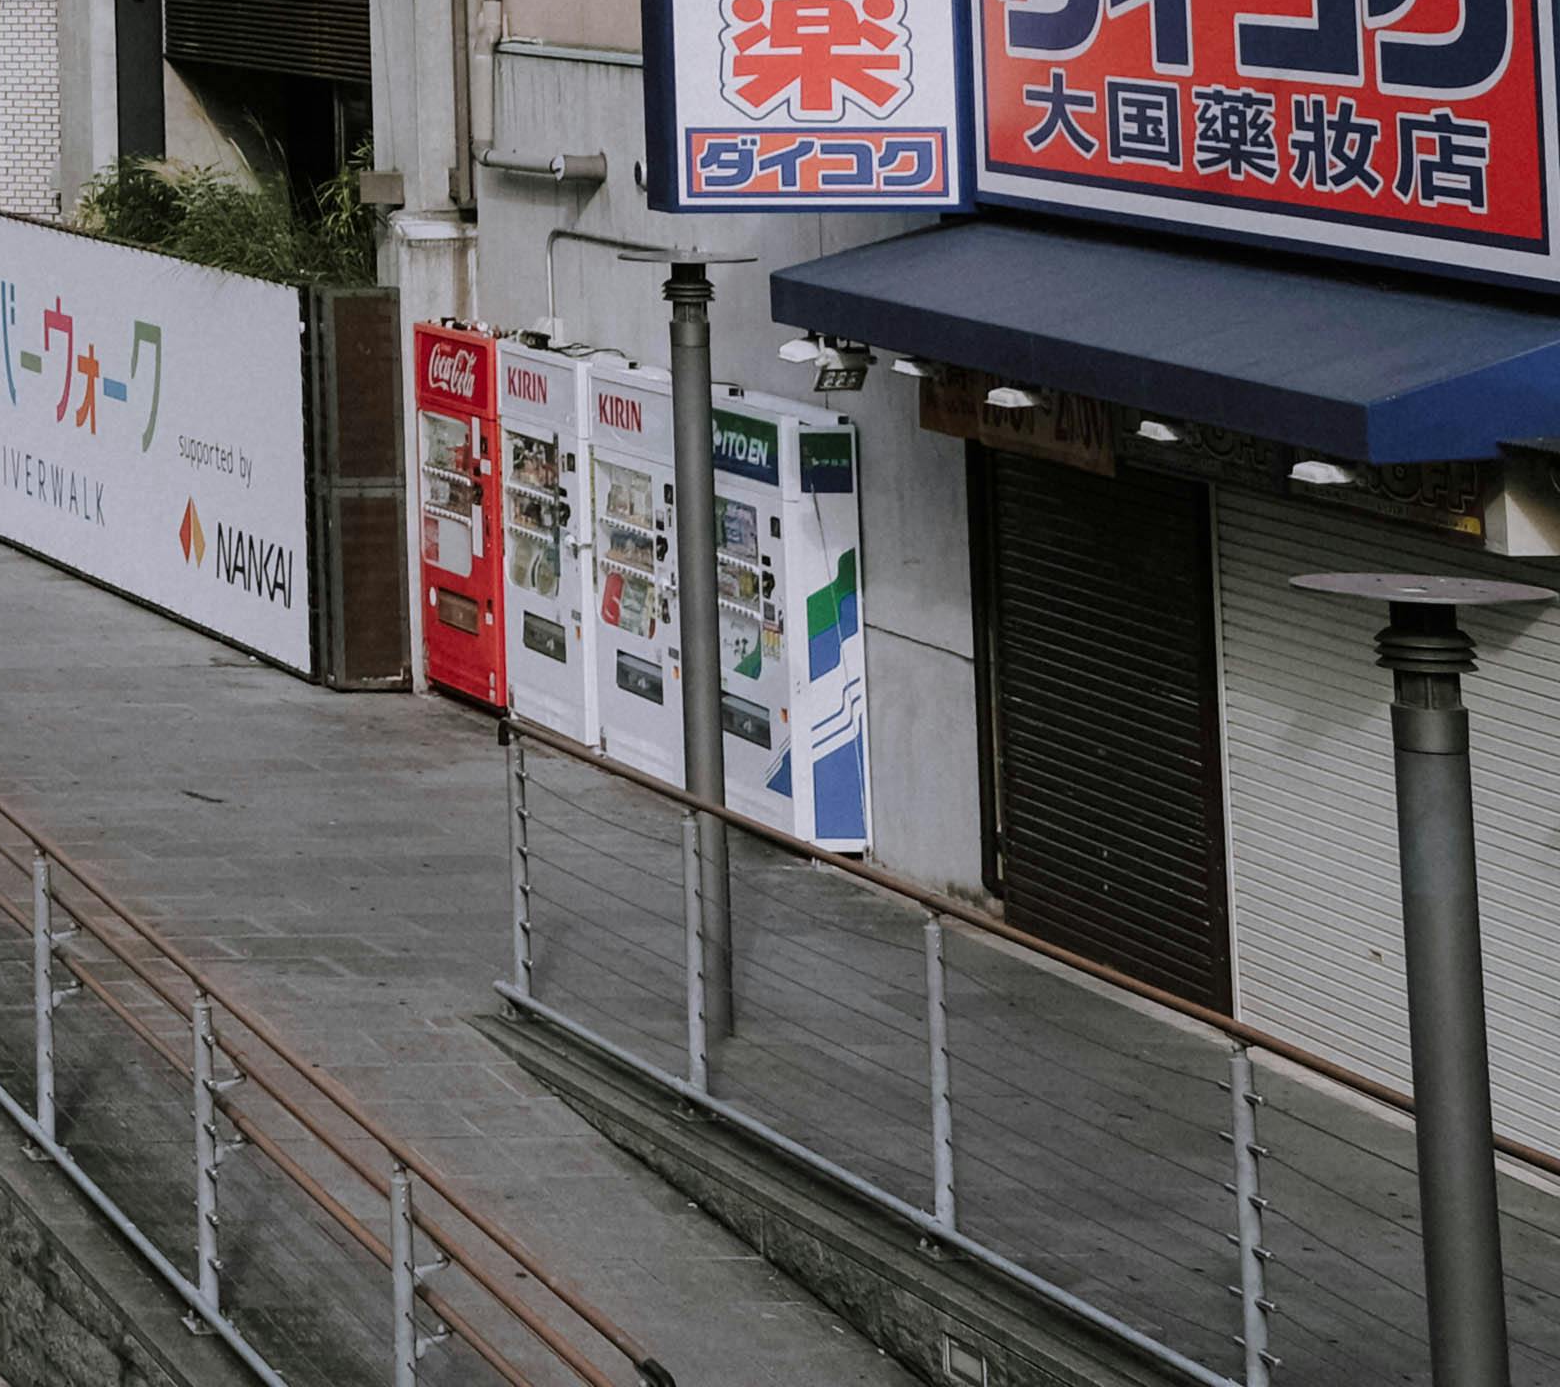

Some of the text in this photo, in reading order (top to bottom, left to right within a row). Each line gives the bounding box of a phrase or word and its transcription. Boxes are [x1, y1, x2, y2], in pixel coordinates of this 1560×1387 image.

[698, 136, 937, 190] ダイコク
[507, 365, 548, 405] KIRIN
[598, 392, 643, 434] KIRIN
[177, 434, 253, 489] supported by
[721, 429, 769, 469] ITO EN
[216, 521, 293, 610] NANKAI
